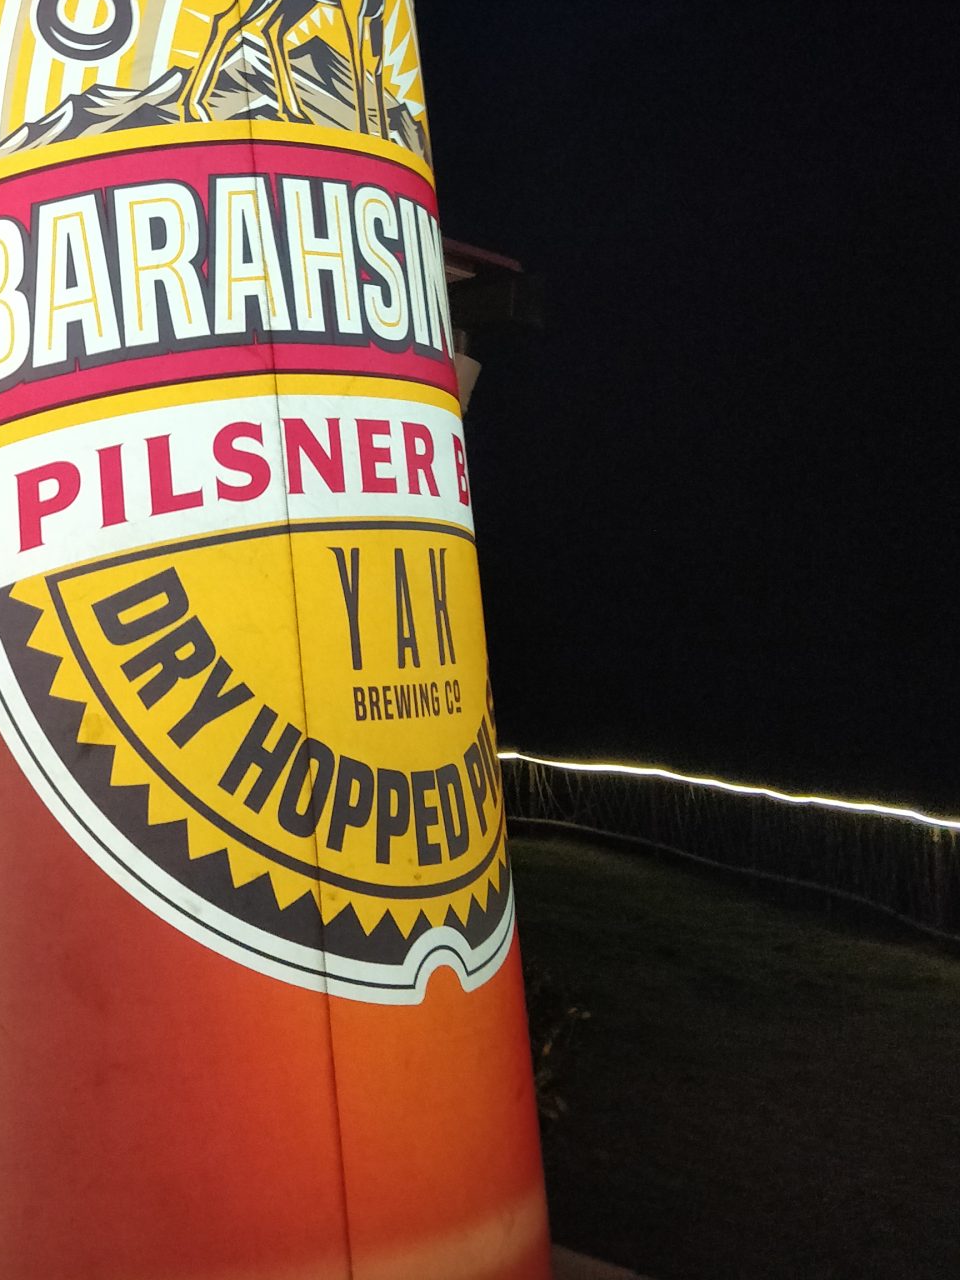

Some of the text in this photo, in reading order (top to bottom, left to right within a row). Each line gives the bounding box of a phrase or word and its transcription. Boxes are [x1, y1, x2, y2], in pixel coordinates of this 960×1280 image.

[16, 417, 440, 553] PILSNER
[326, 546, 456, 670] YAK
[91, 566, 255, 750] DRY
[217, 704, 470, 867] HOPPED
[352, 681, 440, 721] BREWING
